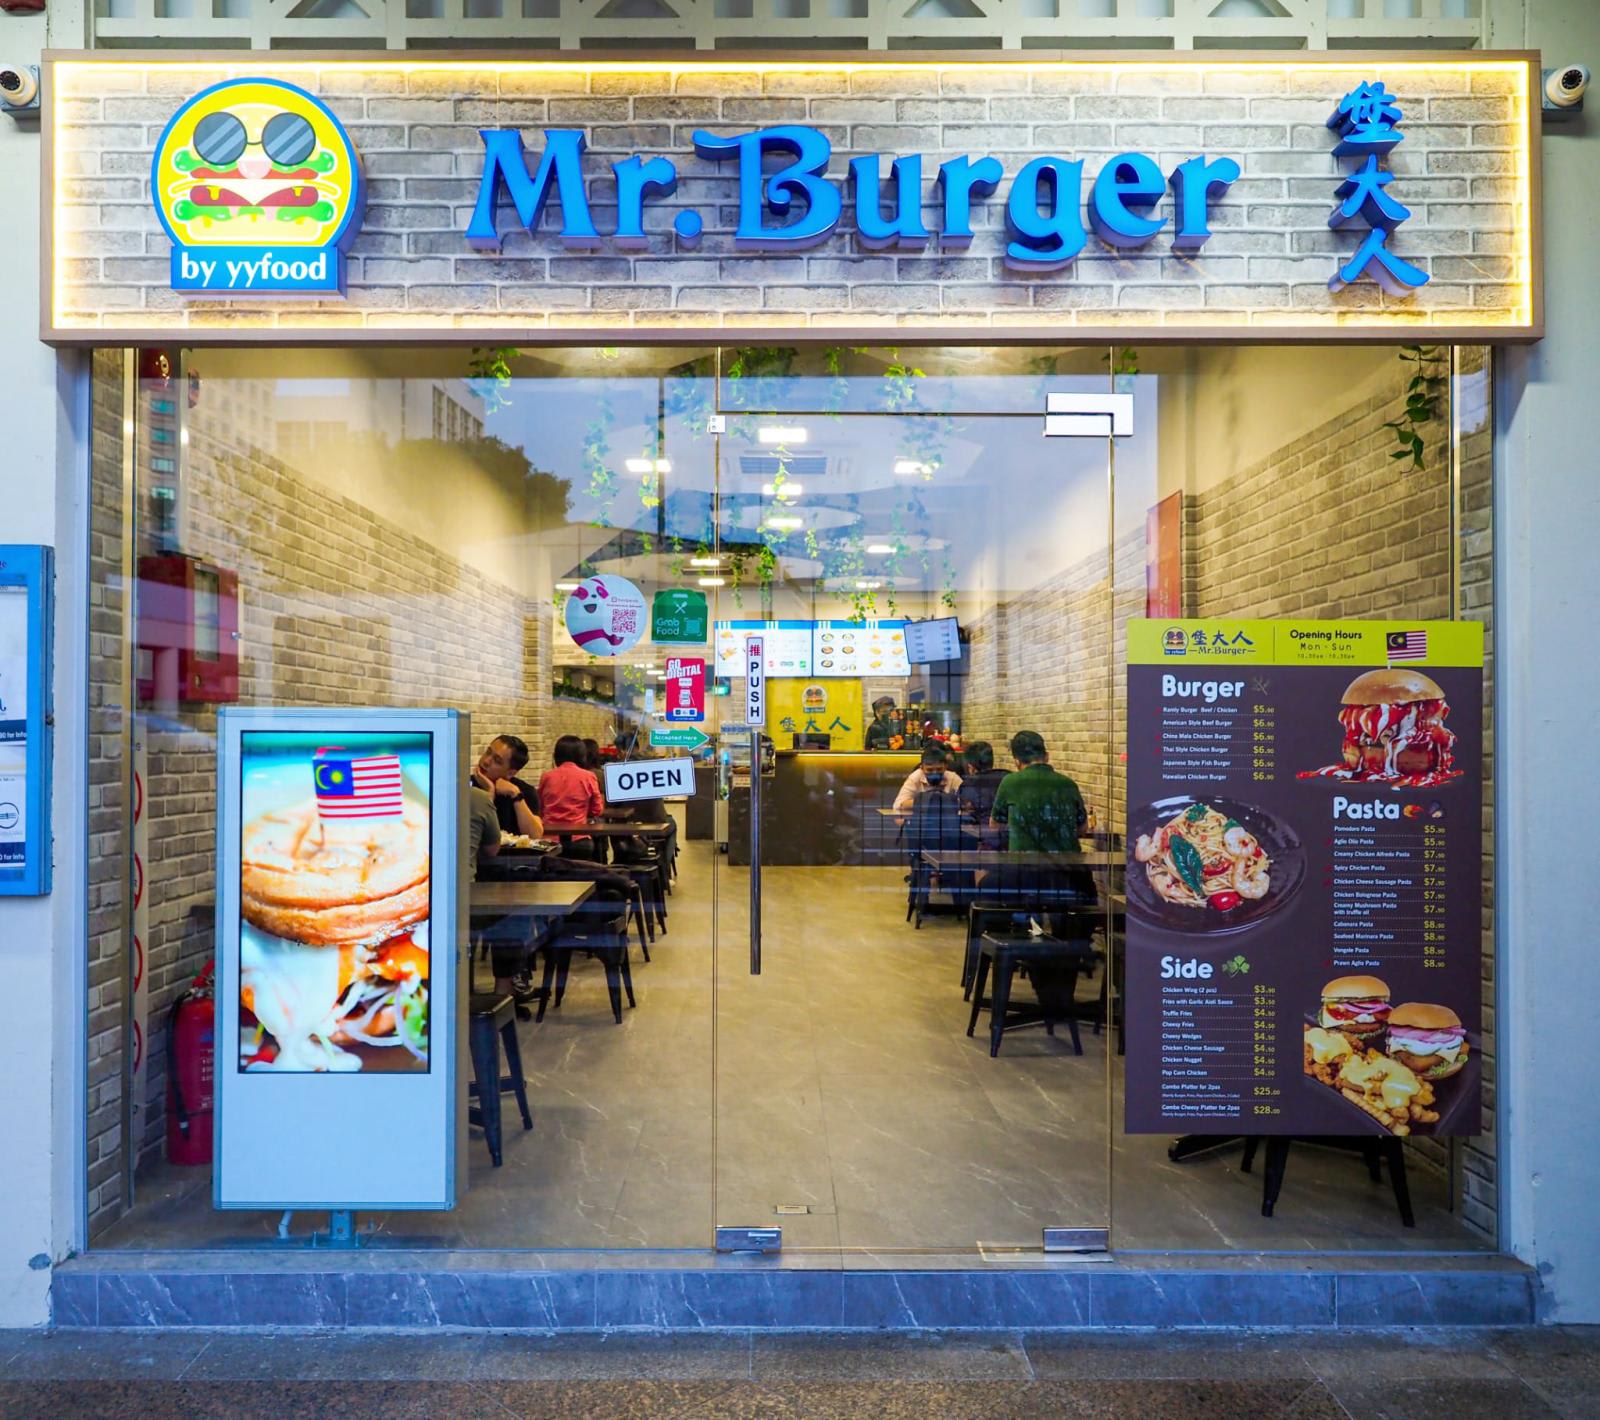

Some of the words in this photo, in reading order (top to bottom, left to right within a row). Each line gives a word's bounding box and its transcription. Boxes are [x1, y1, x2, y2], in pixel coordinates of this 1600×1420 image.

[692, 125, 1241, 261] Burger
[1340, 80, 1430, 287] 堡大人
[181, 251, 217, 288] by
[226, 252, 327, 288] yyfood
[656, 617, 680, 627] Grab
[656, 627, 680, 635] Food
[1290, 630, 1332, 641] Opening
[1335, 630, 1362, 639] Hours
[1332, 643, 1352, 651] Sun
[666, 664, 702, 679] DIGITAL
[668, 659, 681, 670] GO
[750, 661, 760, 717] PUSH
[1162, 674, 1245, 703] Burger
[618, 769, 682, 791] OPEN
[1333, 796, 1400, 819] Pasta
[1161, 956, 1213, 978] Side
